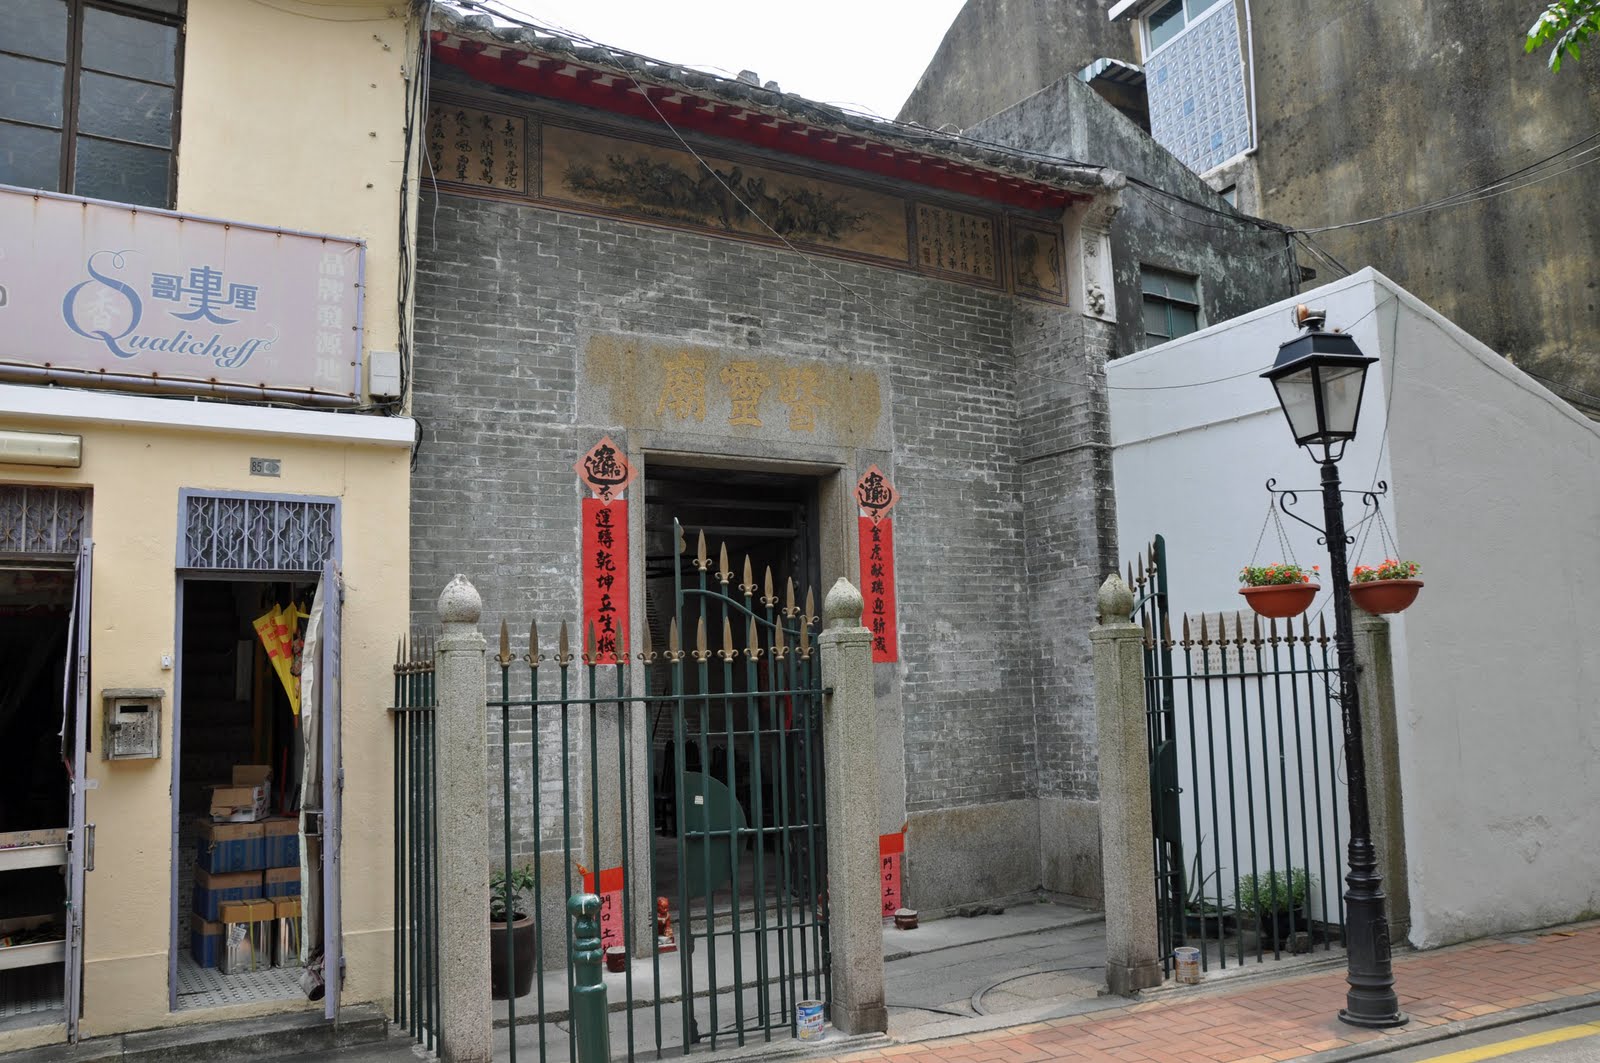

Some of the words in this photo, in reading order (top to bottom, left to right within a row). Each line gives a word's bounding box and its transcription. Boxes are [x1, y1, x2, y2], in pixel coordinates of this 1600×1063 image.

[62, 249, 280, 368] Qualicheff
[252, 461, 262, 472] 85
[883, 856, 896, 911] 門口土地
